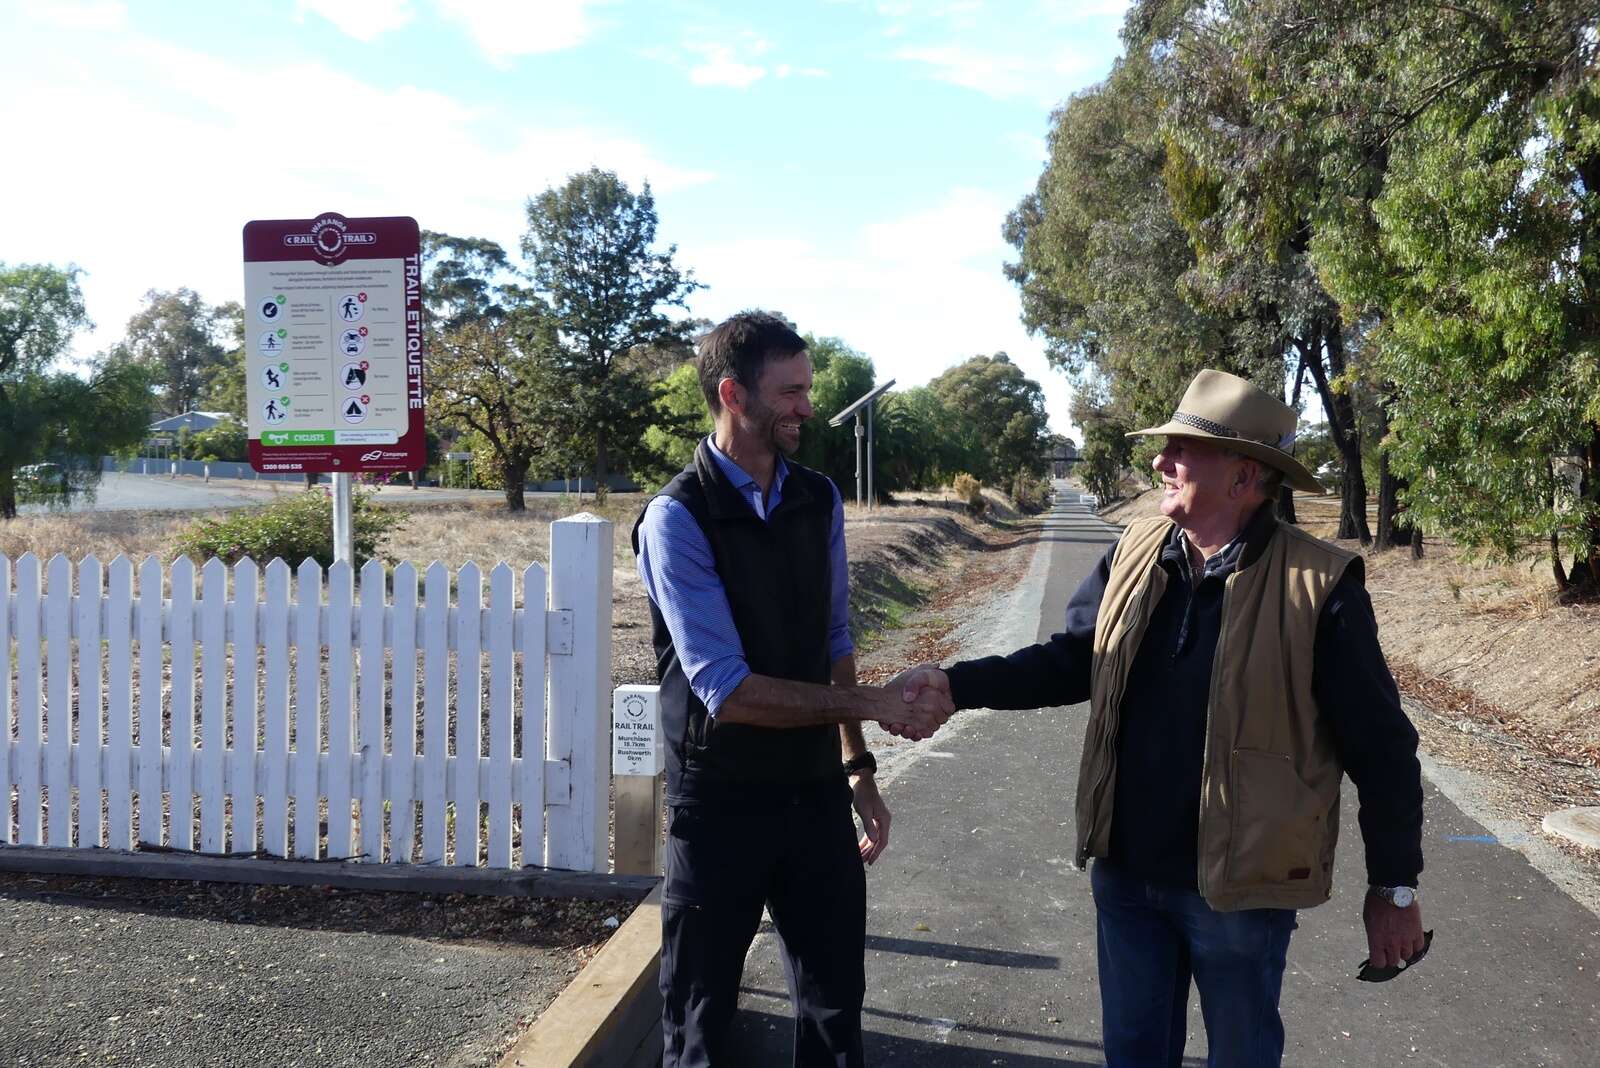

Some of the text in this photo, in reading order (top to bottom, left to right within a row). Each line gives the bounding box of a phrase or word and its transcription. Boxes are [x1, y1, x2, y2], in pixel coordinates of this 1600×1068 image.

[311, 218, 347, 233] WARANGA
[293, 235, 368, 244] RAIL TRAIL
[405, 253, 422, 409] TRAIL ETIQUETTE
[294, 433, 325, 442] CYCLISTS
[623, 693, 648, 704] WARANGA
[615, 722, 654, 730] RAIL TRAIL
